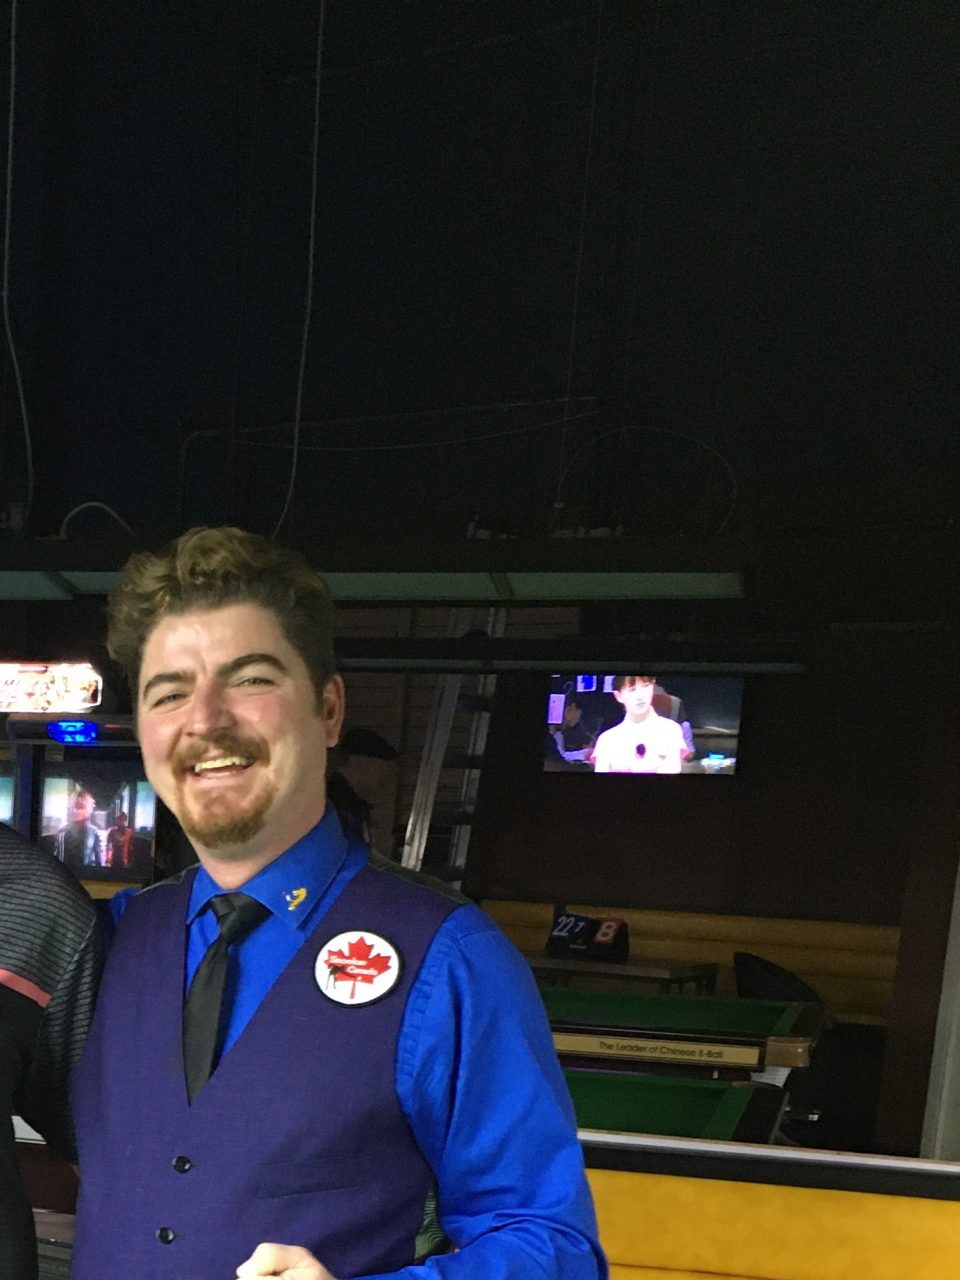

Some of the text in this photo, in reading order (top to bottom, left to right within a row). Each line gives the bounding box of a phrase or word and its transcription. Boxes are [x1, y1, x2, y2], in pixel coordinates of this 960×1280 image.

[552, 916, 575, 936] 22
[596, 921, 617, 941] 8
[346, 966, 378, 976] Canada
[599, 1041, 613, 1050] The
[616, 1042, 647, 1053] Leader
[648, 1046, 658, 1054] of
[660, 1046, 696, 1057] Chinese
